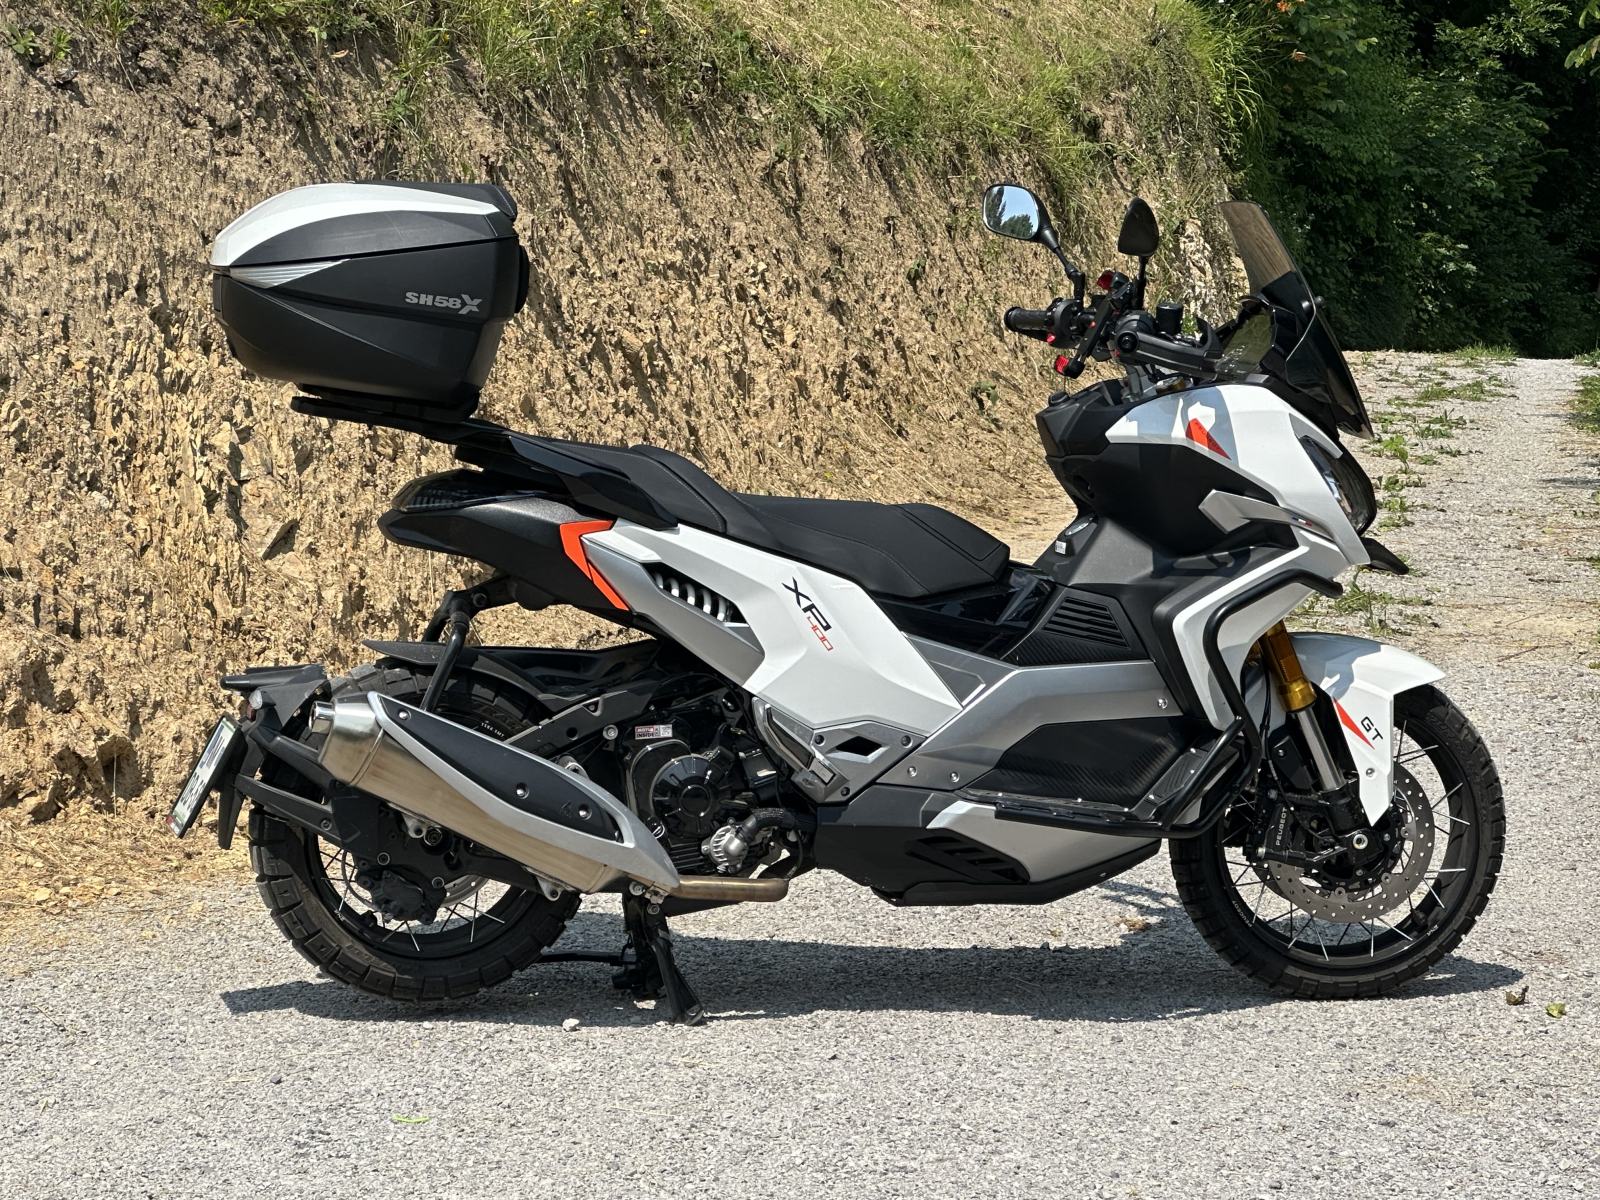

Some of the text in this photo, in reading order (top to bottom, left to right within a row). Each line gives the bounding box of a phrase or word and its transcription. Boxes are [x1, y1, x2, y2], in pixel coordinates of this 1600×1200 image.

[405, 291, 482, 315] SH58X
[781, 576, 832, 632] XP
[806, 616, 834, 651] 400
[1361, 716, 1384, 740] GT
[1275, 807, 1288, 846] PEUGEOT
